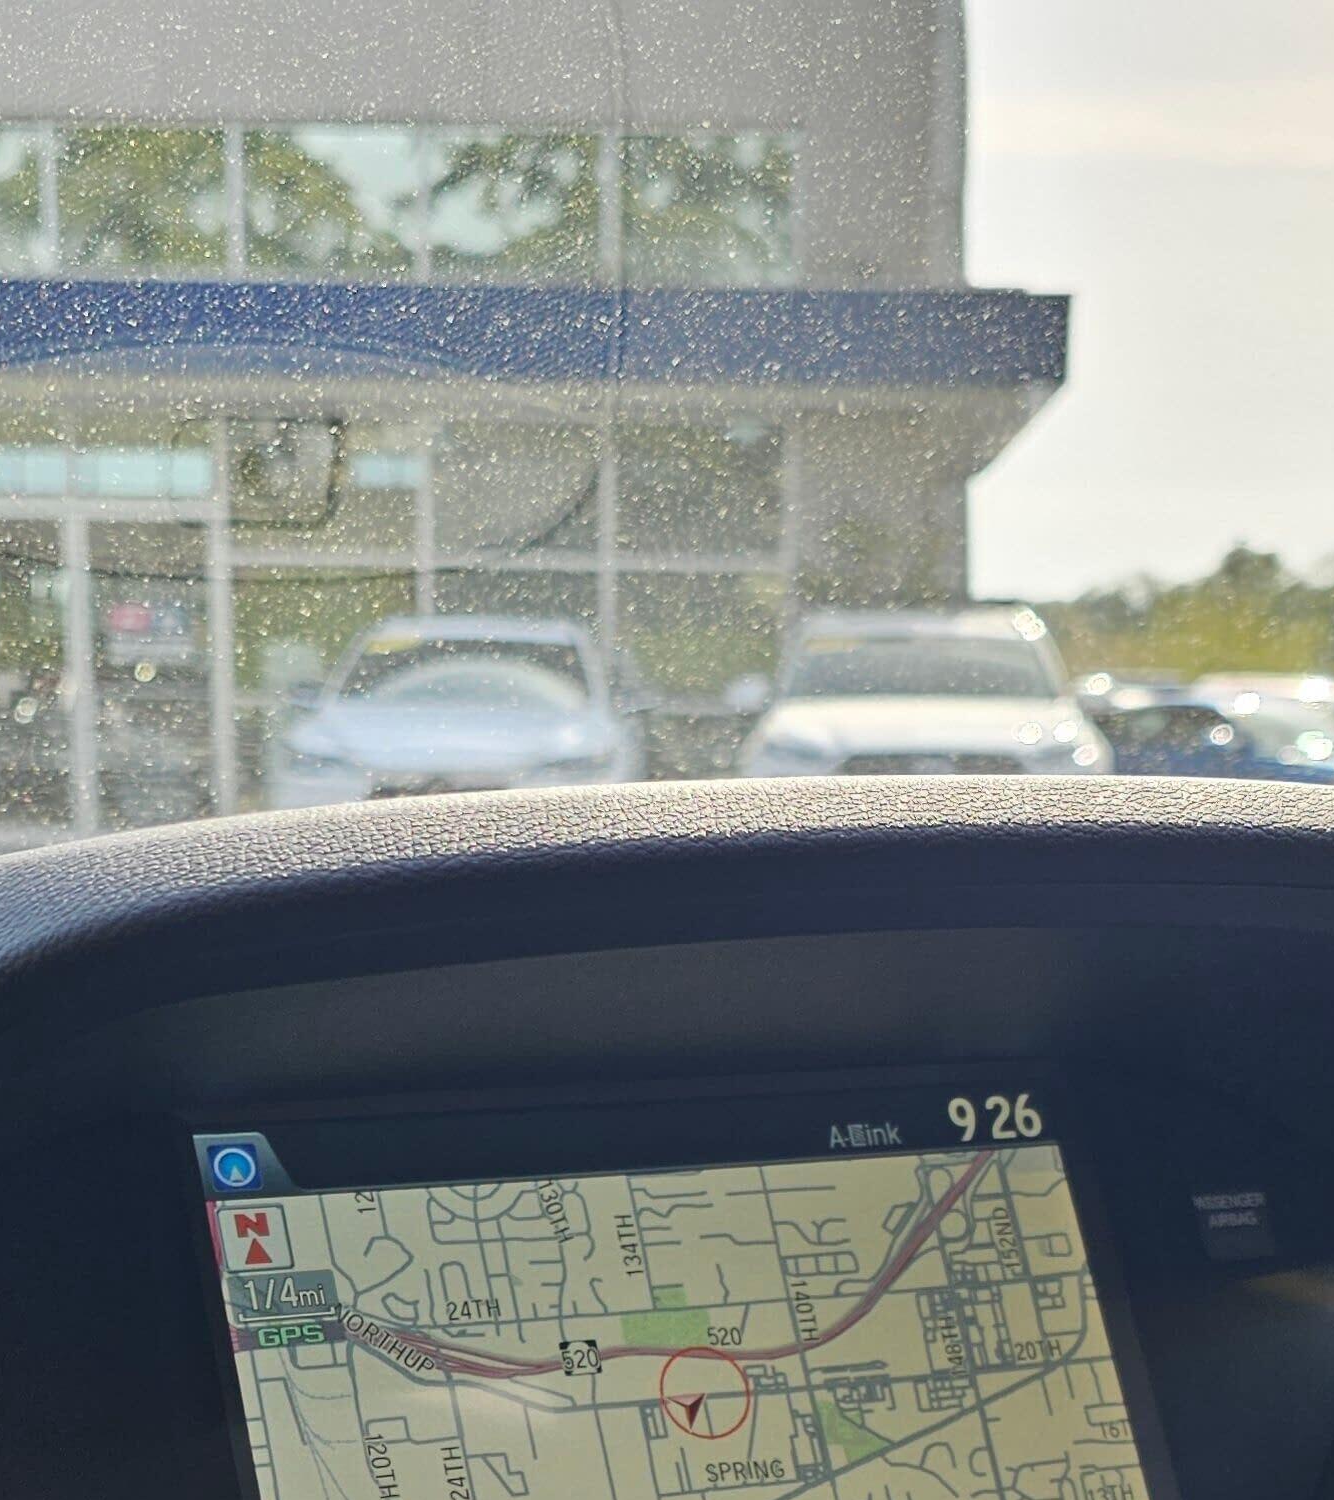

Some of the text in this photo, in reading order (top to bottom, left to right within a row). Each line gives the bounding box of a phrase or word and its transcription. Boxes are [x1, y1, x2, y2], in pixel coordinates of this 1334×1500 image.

[233, 1212, 270, 1238] N
[615, 1215, 644, 1276] 134TH
[993, 1206, 1021, 1270] 152ND
[446, 1299, 501, 1321] 24TH
[791, 1280, 820, 1343] 140TH
[258, 1324, 326, 1348] GPS
[335, 1303, 435, 1373] NORTHUP
[707, 1326, 743, 1346] 520
[561, 1348, 599, 1370] 520
[1015, 1339, 1063, 1361] 20TH
[365, 1434, 400, 1499] 120TH
[705, 1460, 785, 1483] SPRING
